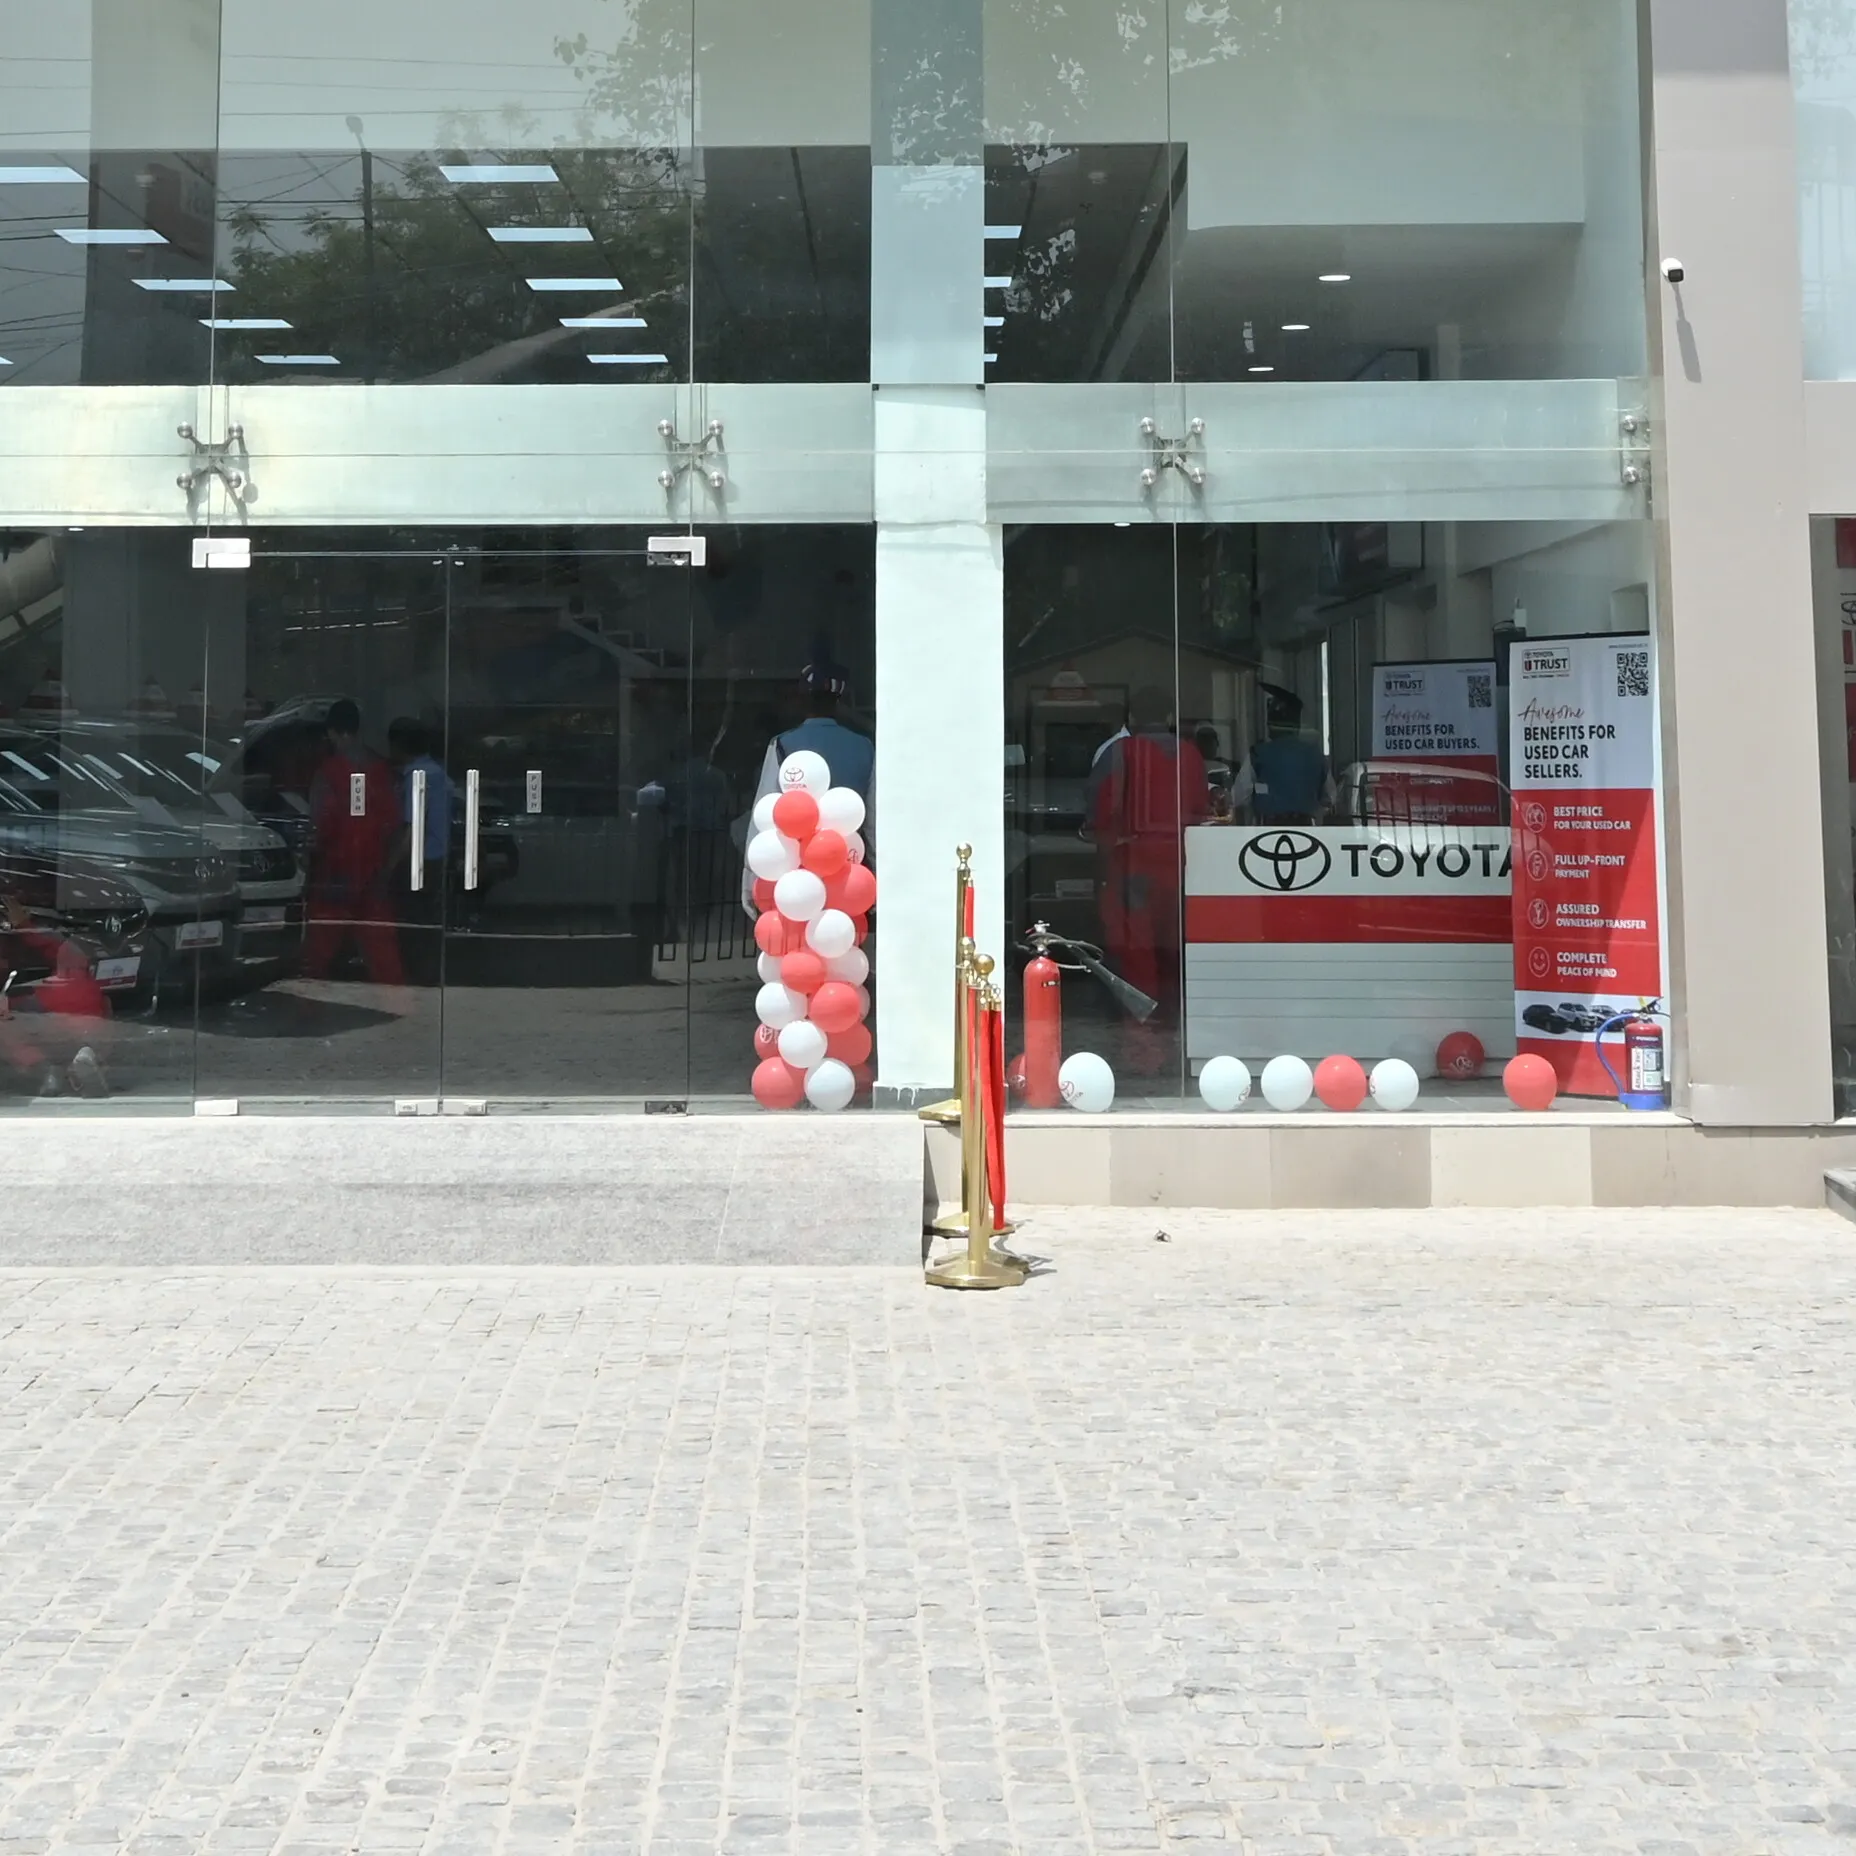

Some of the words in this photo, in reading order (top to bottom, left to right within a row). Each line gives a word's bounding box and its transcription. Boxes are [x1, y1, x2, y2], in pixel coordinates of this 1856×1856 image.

[1533, 658, 1568, 670] TRUST
[1393, 680, 1423, 689] TRUST
[1518, 697, 1584, 726] Awesome
[1385, 724, 1432, 736] BENEFITS
[1434, 724, 1455, 735] FOR
[1524, 725, 1585, 741] BENEFITS
[1588, 724, 1616, 739] FOR
[1385, 739, 1412, 750] USED
[1414, 738, 1435, 750] CAR
[1437, 738, 1481, 750] BUYERS.
[1524, 745, 1559, 760] USED
[1562, 744, 1589, 759] CAR
[1524, 763, 1583, 779] SELLERS.
[1553, 806, 1575, 817] BEST
[1577, 806, 1603, 817] PRICE
[1553, 821, 1570, 830] FOR
[1571, 821, 1592, 830] YOUR
[1593, 821, 1613, 830] USED
[1614, 821, 1631, 830] CAR
[1555, 855, 1577, 865] FULL
[1578, 855, 1626, 867] UP-FRONT
[1555, 869, 1590, 879] PAYMENT
[1556, 904, 1600, 915] ASSURED
[1556, 918, 1604, 928] OWNERSHIP
[1605, 919, 1647, 930] TRANSFER
[1556, 952, 1607, 964] COMPLETE
[1557, 967, 1582, 976] PEACE
[1583, 967, 1594, 976] OF
[1595, 968, 1618, 978] MIND
